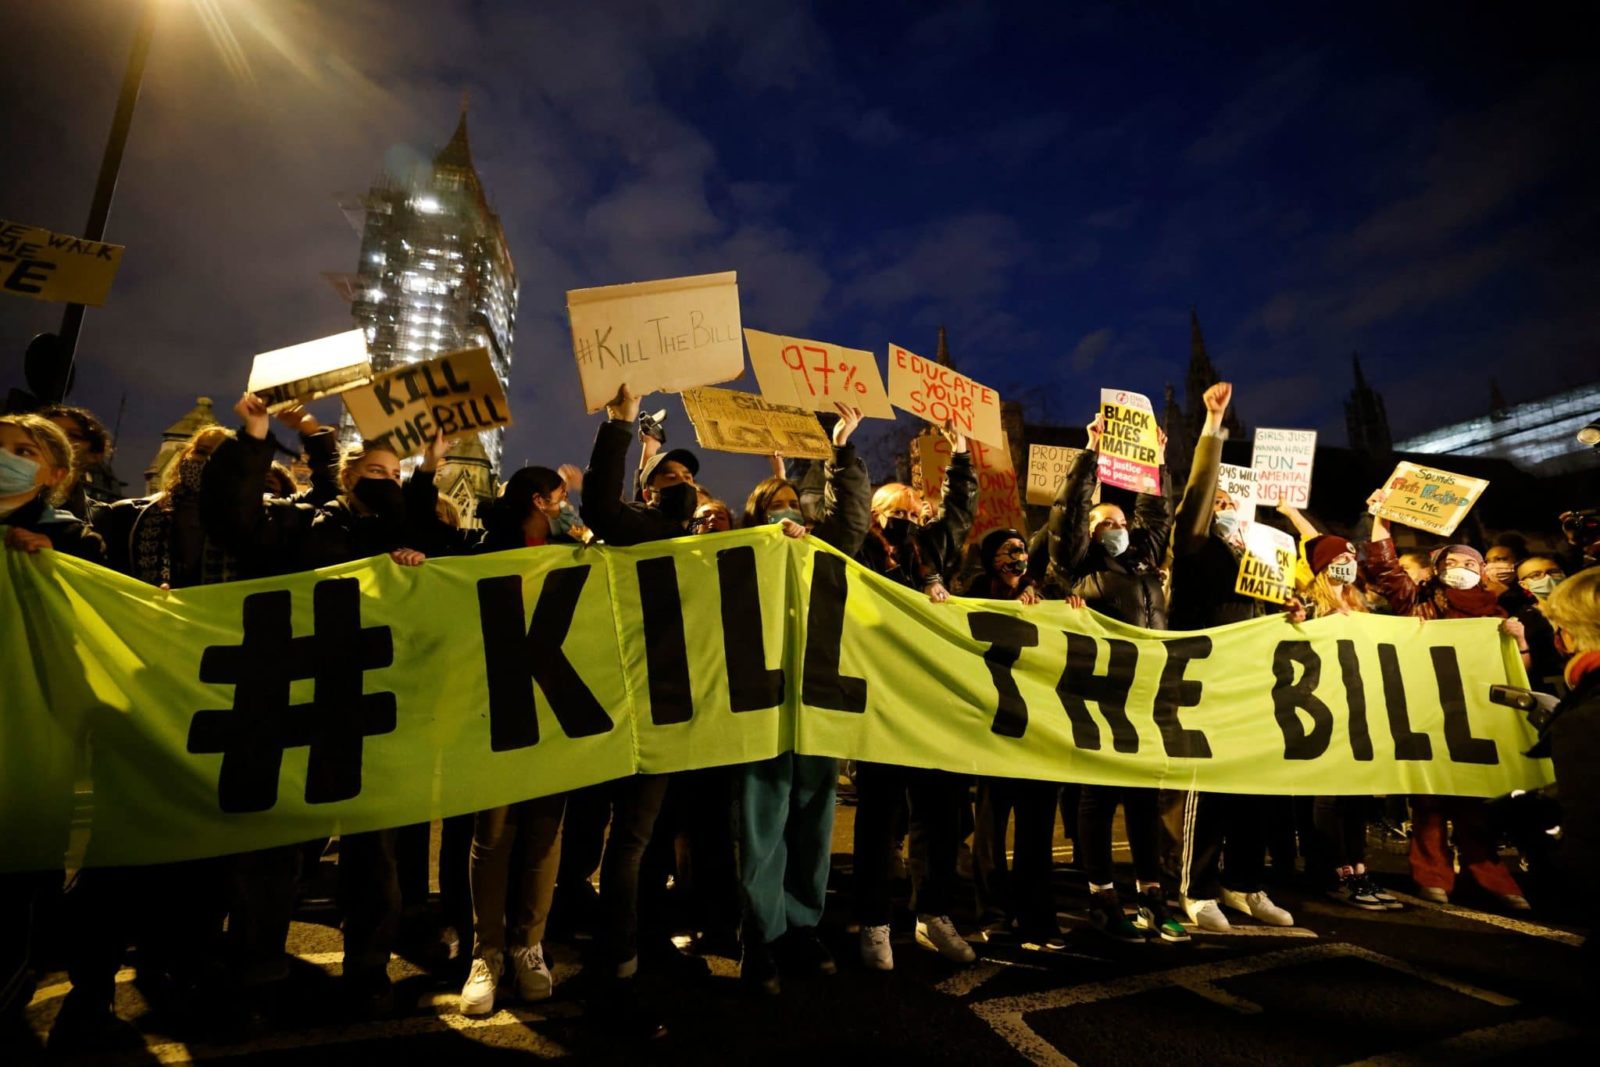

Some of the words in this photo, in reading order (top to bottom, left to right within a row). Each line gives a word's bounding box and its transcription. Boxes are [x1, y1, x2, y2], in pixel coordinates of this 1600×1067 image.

[48, 233, 112, 261] WALK
[781, 344, 868, 396] 97%
[896, 349, 993, 406] EDUCATE
[373, 359, 471, 416] KILL
[923, 379, 975, 419] YOUR
[910, 391, 973, 432] SON
[1104, 405, 1150, 430] BLACK
[1103, 420, 1141, 443] LIVES
[1255, 431, 1284, 441] GIRLS
[1287, 431, 1314, 442] JUST
[1032, 445, 1075, 462] PROTE
[1102, 435, 1156, 464] MATTER
[1255, 445, 1282, 453] WANNA
[1284, 446, 1311, 455] HAVE
[1031, 461, 1048, 473] FOR
[1053, 462, 1067, 474] OU
[1100, 465, 1112, 477] No
[1219, 465, 1237, 479] OYS
[1239, 468, 1258, 483] WILL
[1257, 470, 1308, 483] AMENTAL
[1031, 473, 1047, 487] TO
[1228, 482, 1250, 499] BOYS
[1243, 559, 1284, 583] LIVES
[1330, 566, 1351, 576] TELL
[1240, 575, 1296, 600] MATTE
[967, 611, 1213, 759] THE
[1271, 639, 1500, 765] BILL
